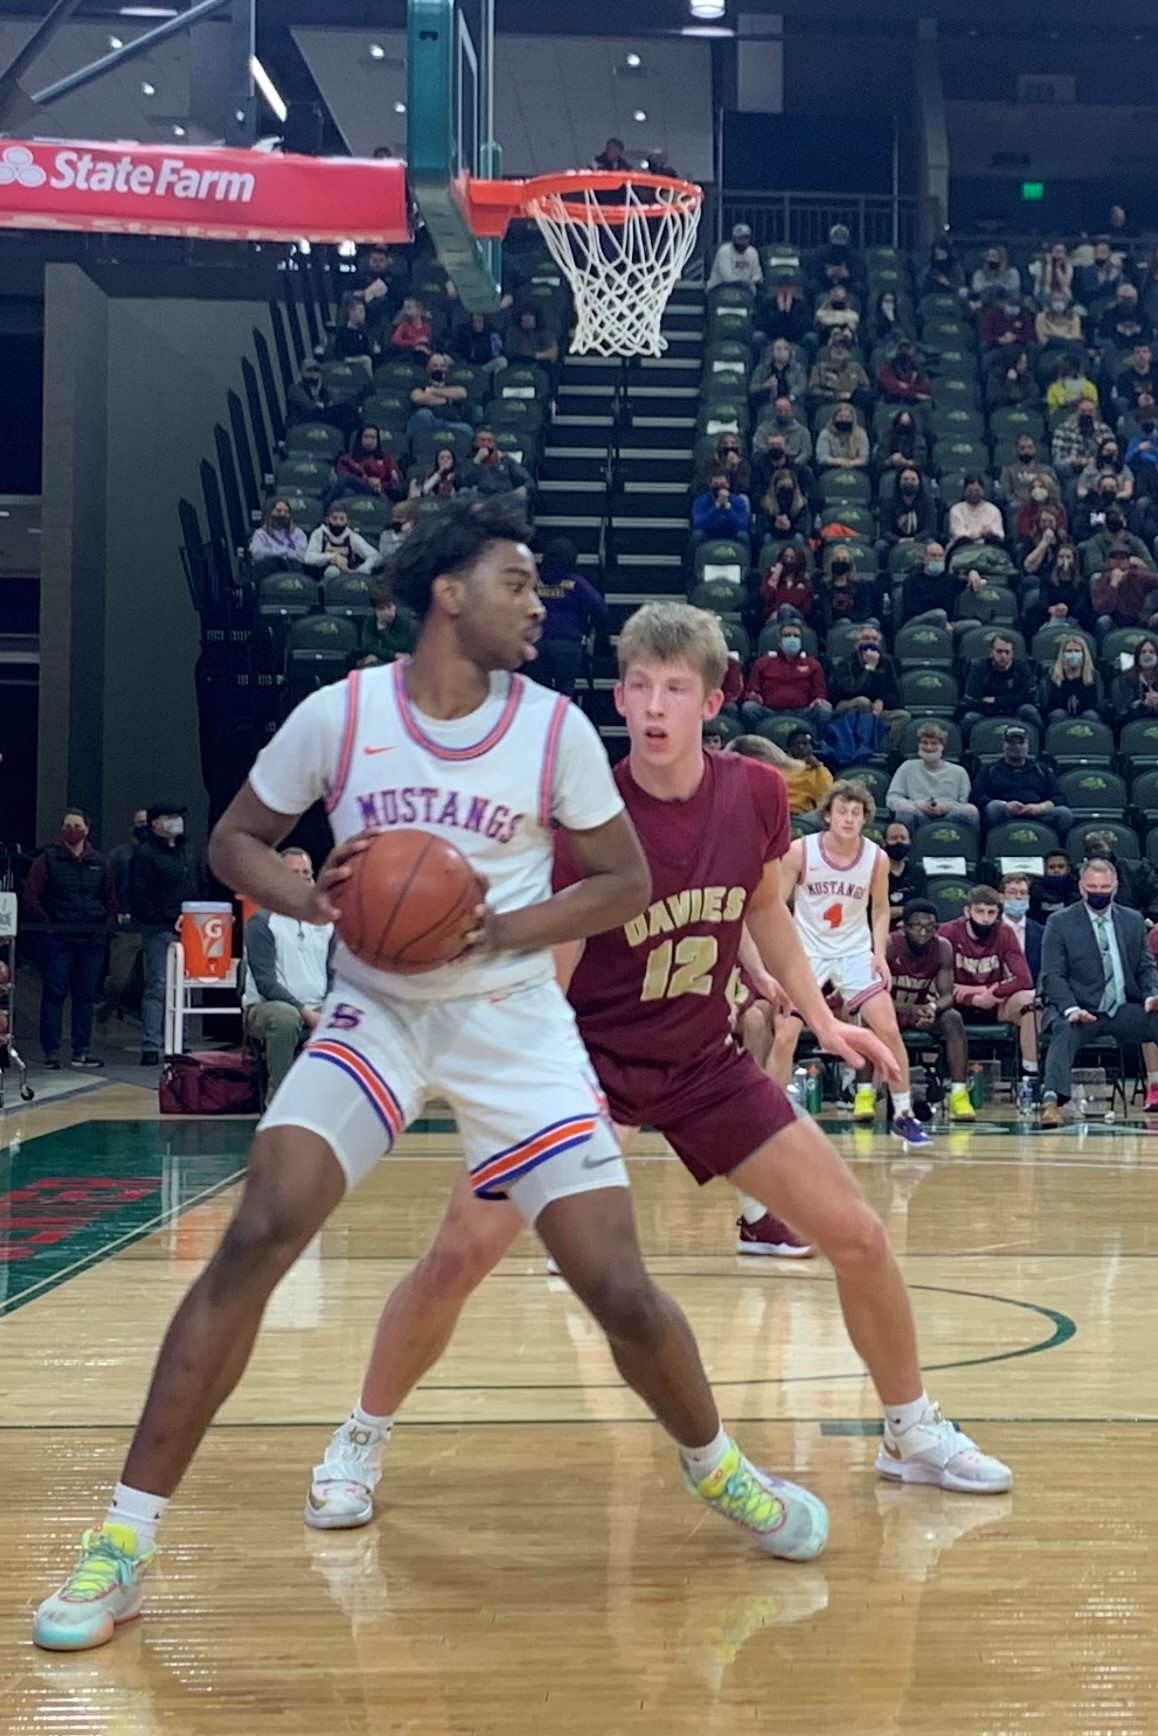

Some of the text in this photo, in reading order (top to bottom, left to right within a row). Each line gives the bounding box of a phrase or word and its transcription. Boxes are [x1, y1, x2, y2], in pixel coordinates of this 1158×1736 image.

[50, 151, 255, 202] State Farm
[356, 787, 526, 844] MUSTANGS
[205, 918, 222, 938] G
[624, 886, 747, 947] DAVIES
[823, 903, 843, 929] 4
[640, 935, 718, 1001] 12
